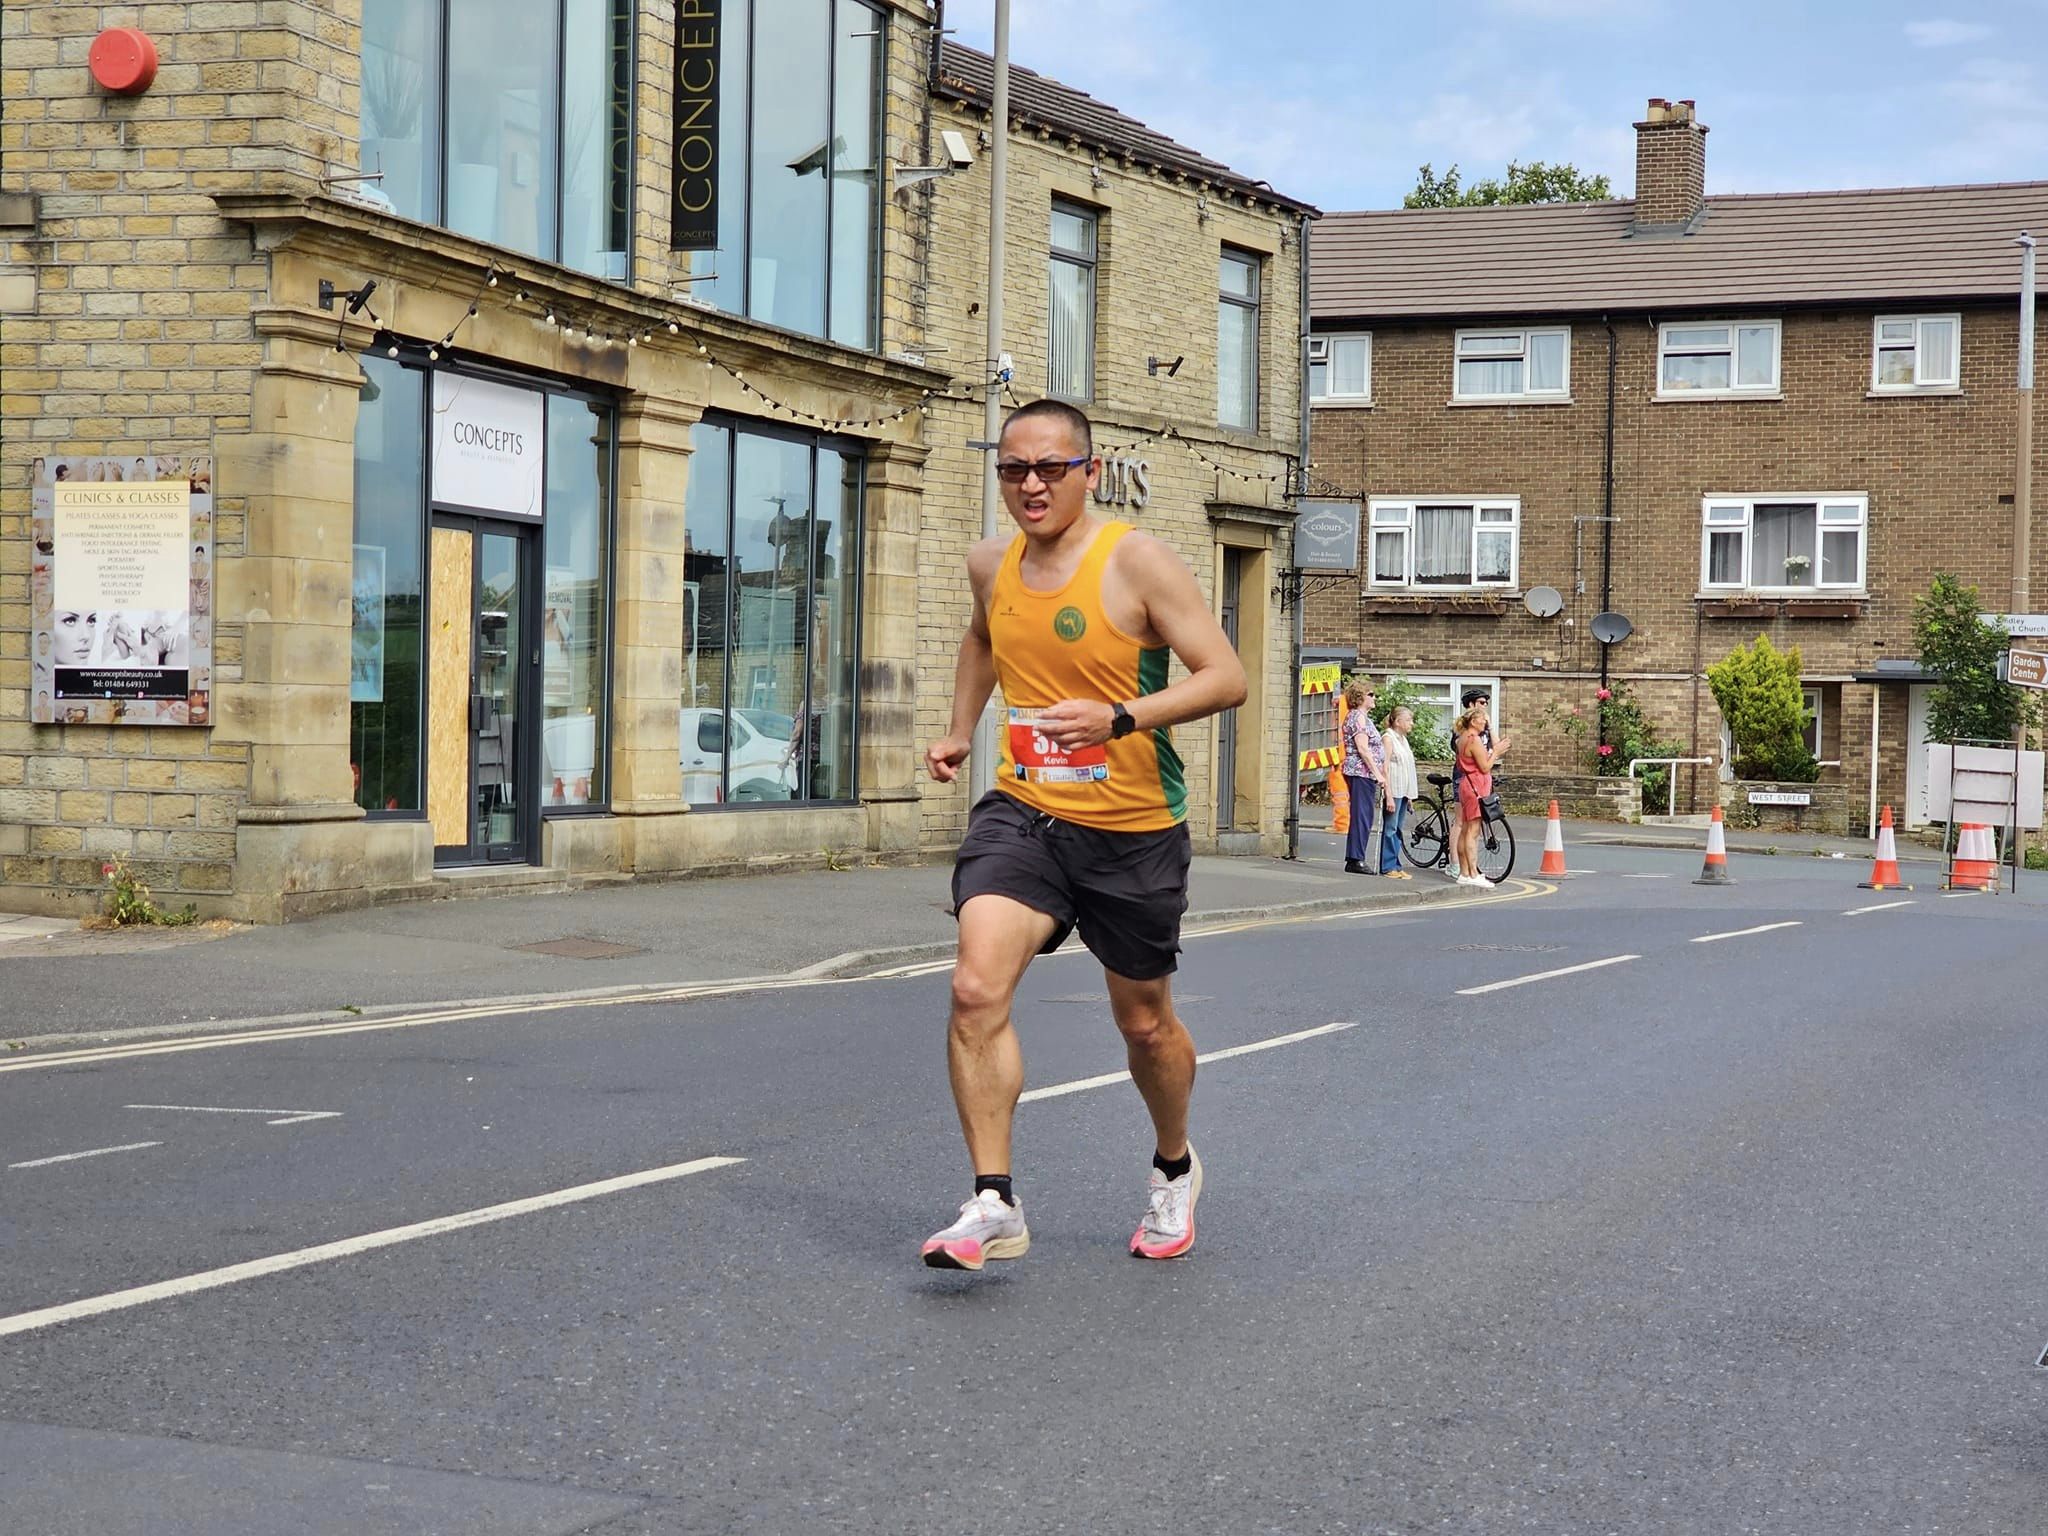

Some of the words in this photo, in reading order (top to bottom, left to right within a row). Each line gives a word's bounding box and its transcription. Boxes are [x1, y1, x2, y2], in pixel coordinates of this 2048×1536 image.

[454, 422, 523, 455] CONCEPTS
[63, 492, 112, 504] CLINICS
[116, 493, 125, 504] &
[129, 492, 180, 504] CLASSES
[65, 512, 91, 520] PILATES
[92, 512, 120, 520] CLASSES
[121, 512, 127, 520] &
[128, 512, 148, 520] YOGA
[150, 512, 178, 520] CLASSES
[1310, 522, 1342, 532] colours
[2018, 625, 2046, 633] Church
[2013, 655, 2041, 669] Garden
[80, 671, 163, 679] www.conceptsbeauty.co.uk
[2012, 666, 2039, 680] Centre
[93, 680, 103, 688] Tel:
[1043, 756, 1068, 765] Kevin
